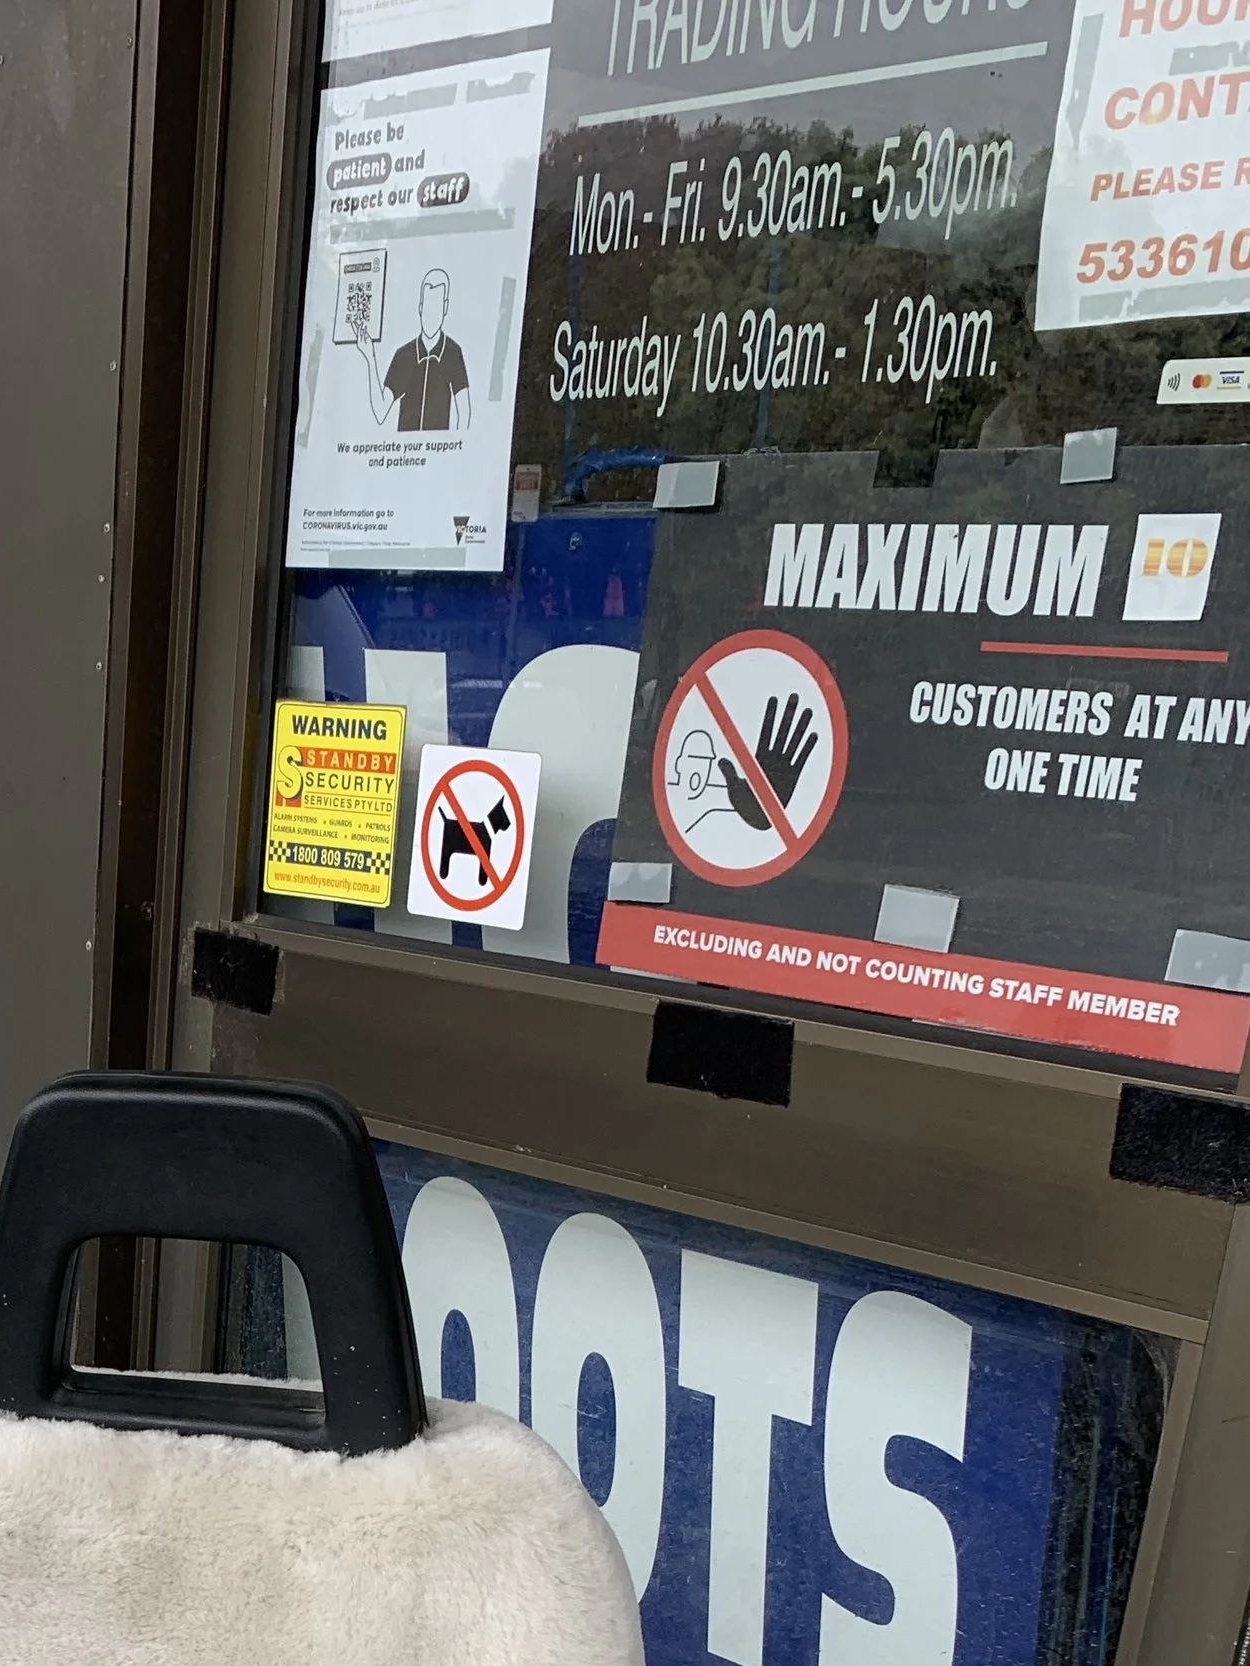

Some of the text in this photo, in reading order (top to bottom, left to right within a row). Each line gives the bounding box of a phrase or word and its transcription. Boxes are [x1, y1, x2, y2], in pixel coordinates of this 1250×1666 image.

[1104, 71, 1250, 130] CONT
[335, 122, 404, 150] Please be
[333, 149, 425, 185] patient and
[569, 173, 638, 255] Mon.
[661, 158, 705, 245] Fri.
[718, 149, 846, 241] 9.30am.
[873, 127, 1017, 240] 5.30pm.
[1090, 161, 1224, 201] PLEASE
[330, 177, 465, 215] respect our staff
[550, 316, 681, 417] Saturday
[692, 307, 830, 393] 10.30am.
[862, 294, 996, 404] 1.30pm.
[1222, 376, 1240, 384] VISA
[337, 440, 463, 454] We appreciate your support
[368, 455, 426, 468] and patience
[334, 508, 374, 517] information
[303, 521, 388, 531] CORONAVIRUS.vic.gov.au
[763, 523, 1208, 617] MAXIMUM 10
[909, 681, 1250, 745] CUSTOMERS AT ANY
[292, 714, 387, 740] WARNING
[307, 750, 394, 771] STANDBY
[305, 771, 394, 793] SECURITY
[984, 747, 1143, 802] ONE TIME
[304, 795, 392, 813] SERVICES PTY LTD
[273, 825, 389, 843] CAMERA SURVEILLANCE MONITORING
[365, 822, 390, 832] PATROLS
[293, 845, 365, 869] 1800 809 579
[274, 870, 380, 894] www.standbysecurity.com.au
[653, 925, 1181, 1026] EXCLUDING AND NOT COUNTING STAFF MEMBER
